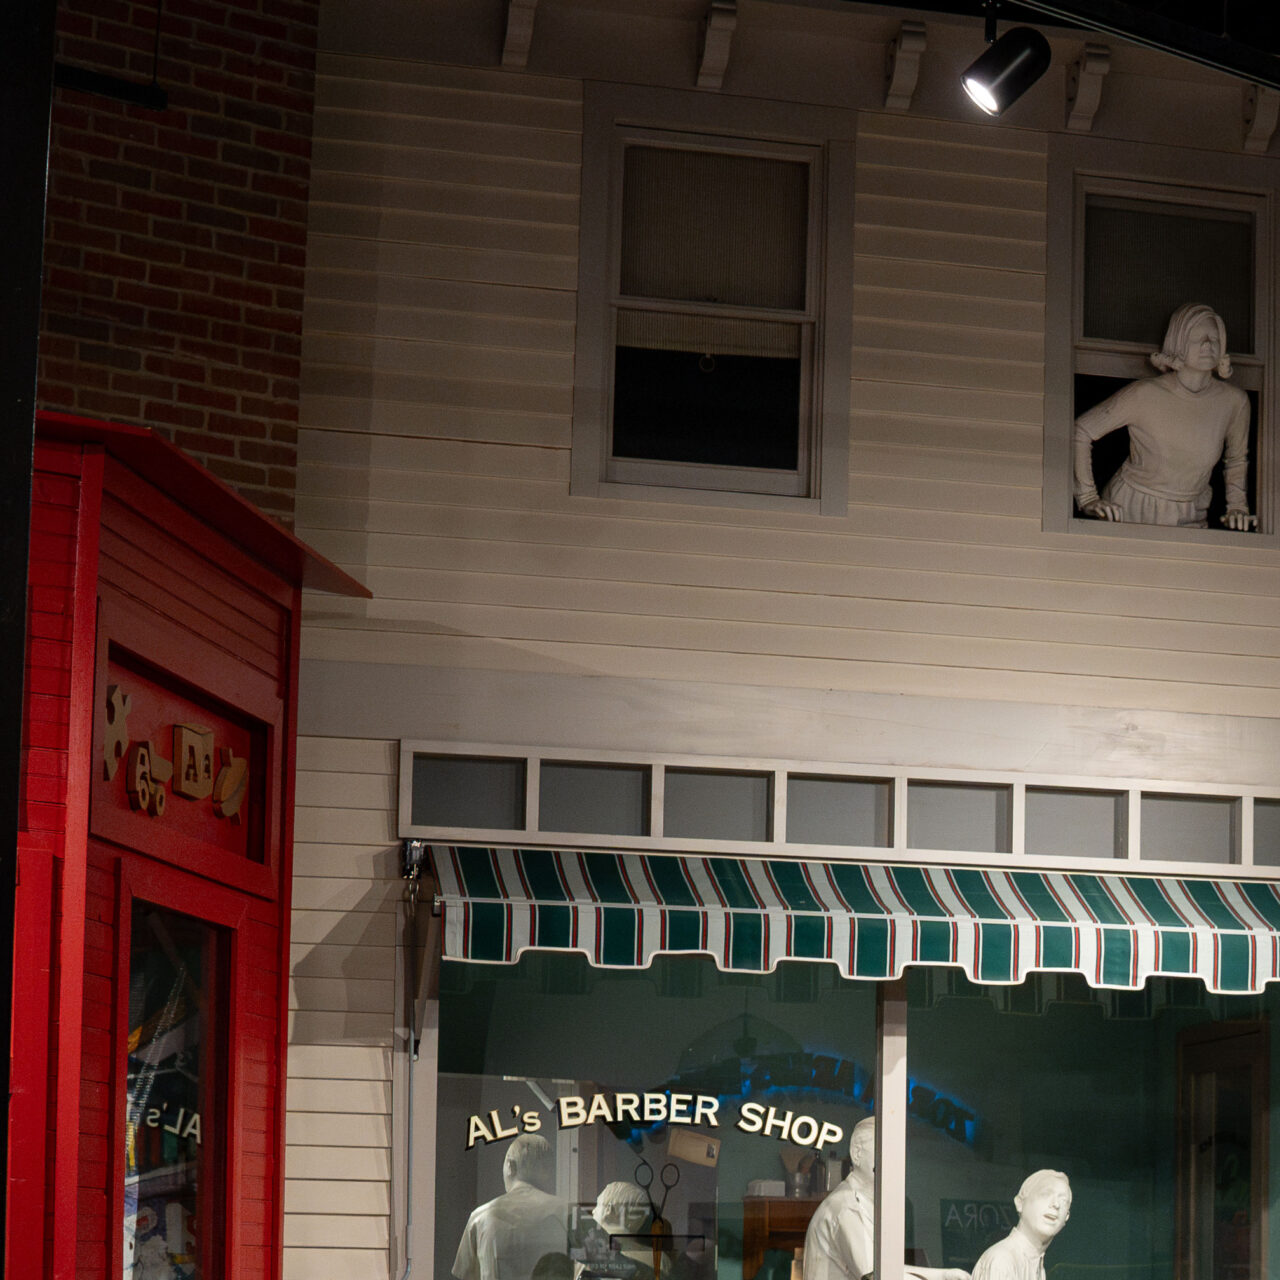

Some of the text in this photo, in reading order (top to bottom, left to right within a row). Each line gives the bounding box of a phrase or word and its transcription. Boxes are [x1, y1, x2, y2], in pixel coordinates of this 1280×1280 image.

[467, 1092, 844, 1151] AL's BARBER SHOP
